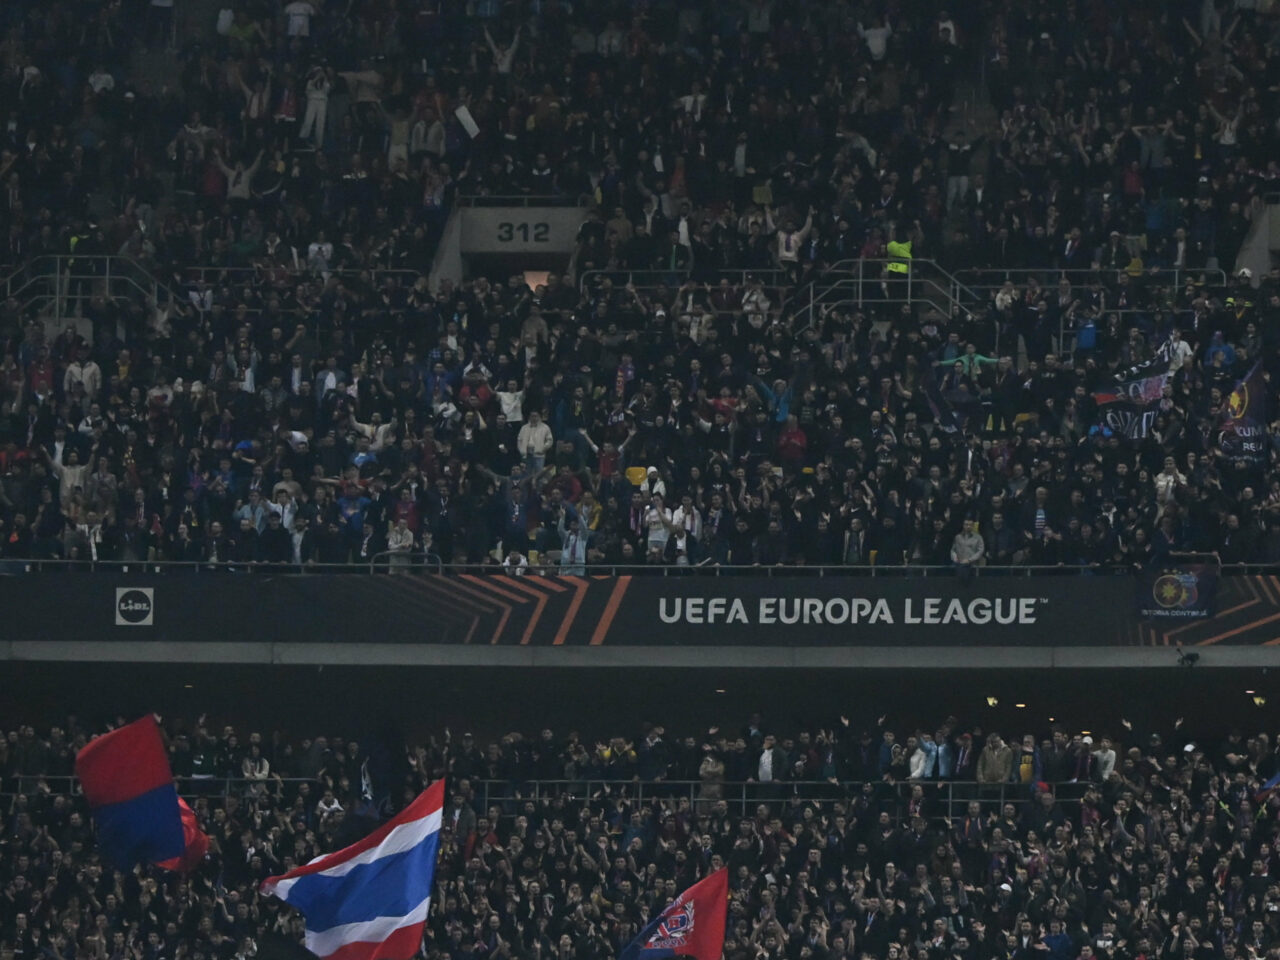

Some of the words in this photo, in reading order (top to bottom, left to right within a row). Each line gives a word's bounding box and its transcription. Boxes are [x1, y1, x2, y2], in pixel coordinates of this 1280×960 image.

[498, 222, 550, 242] 312
[659, 597, 749, 624] UEFA
[758, 597, 894, 624] EUROPA
